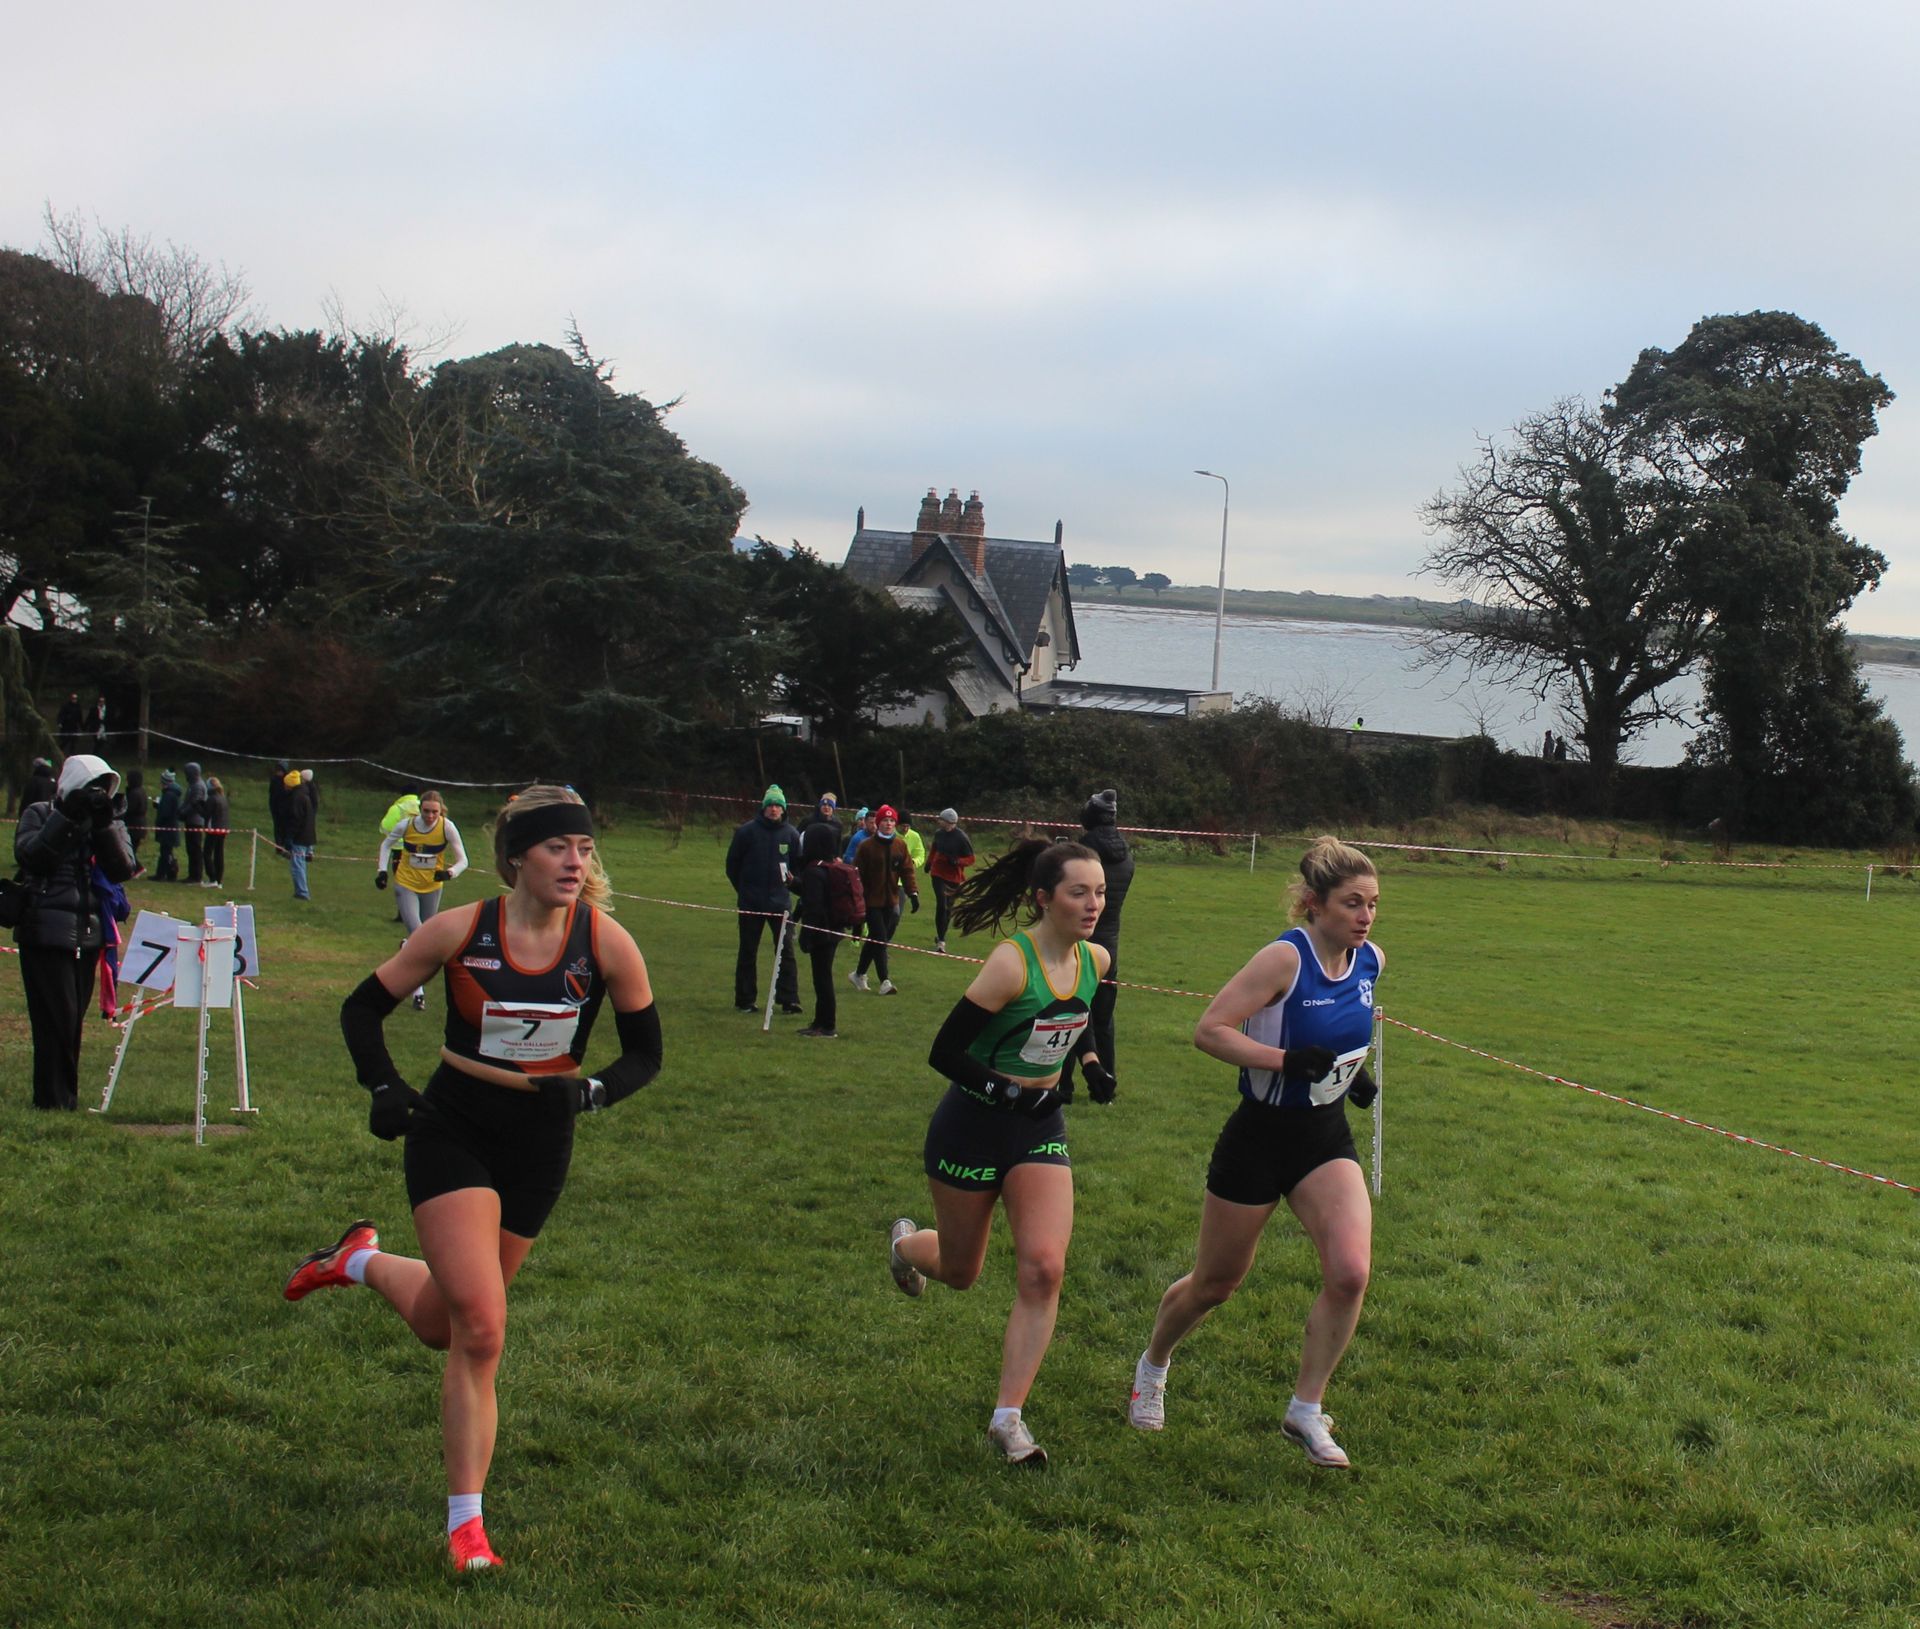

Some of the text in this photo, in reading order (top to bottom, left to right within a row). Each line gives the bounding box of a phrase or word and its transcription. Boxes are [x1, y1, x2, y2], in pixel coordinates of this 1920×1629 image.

[135, 941, 171, 984] 7
[522, 1019, 542, 1041] 7
[1046, 1029, 1072, 1048] 41
[1333, 1062, 1358, 1085] 17
[938, 1158, 997, 1181] NIKE
